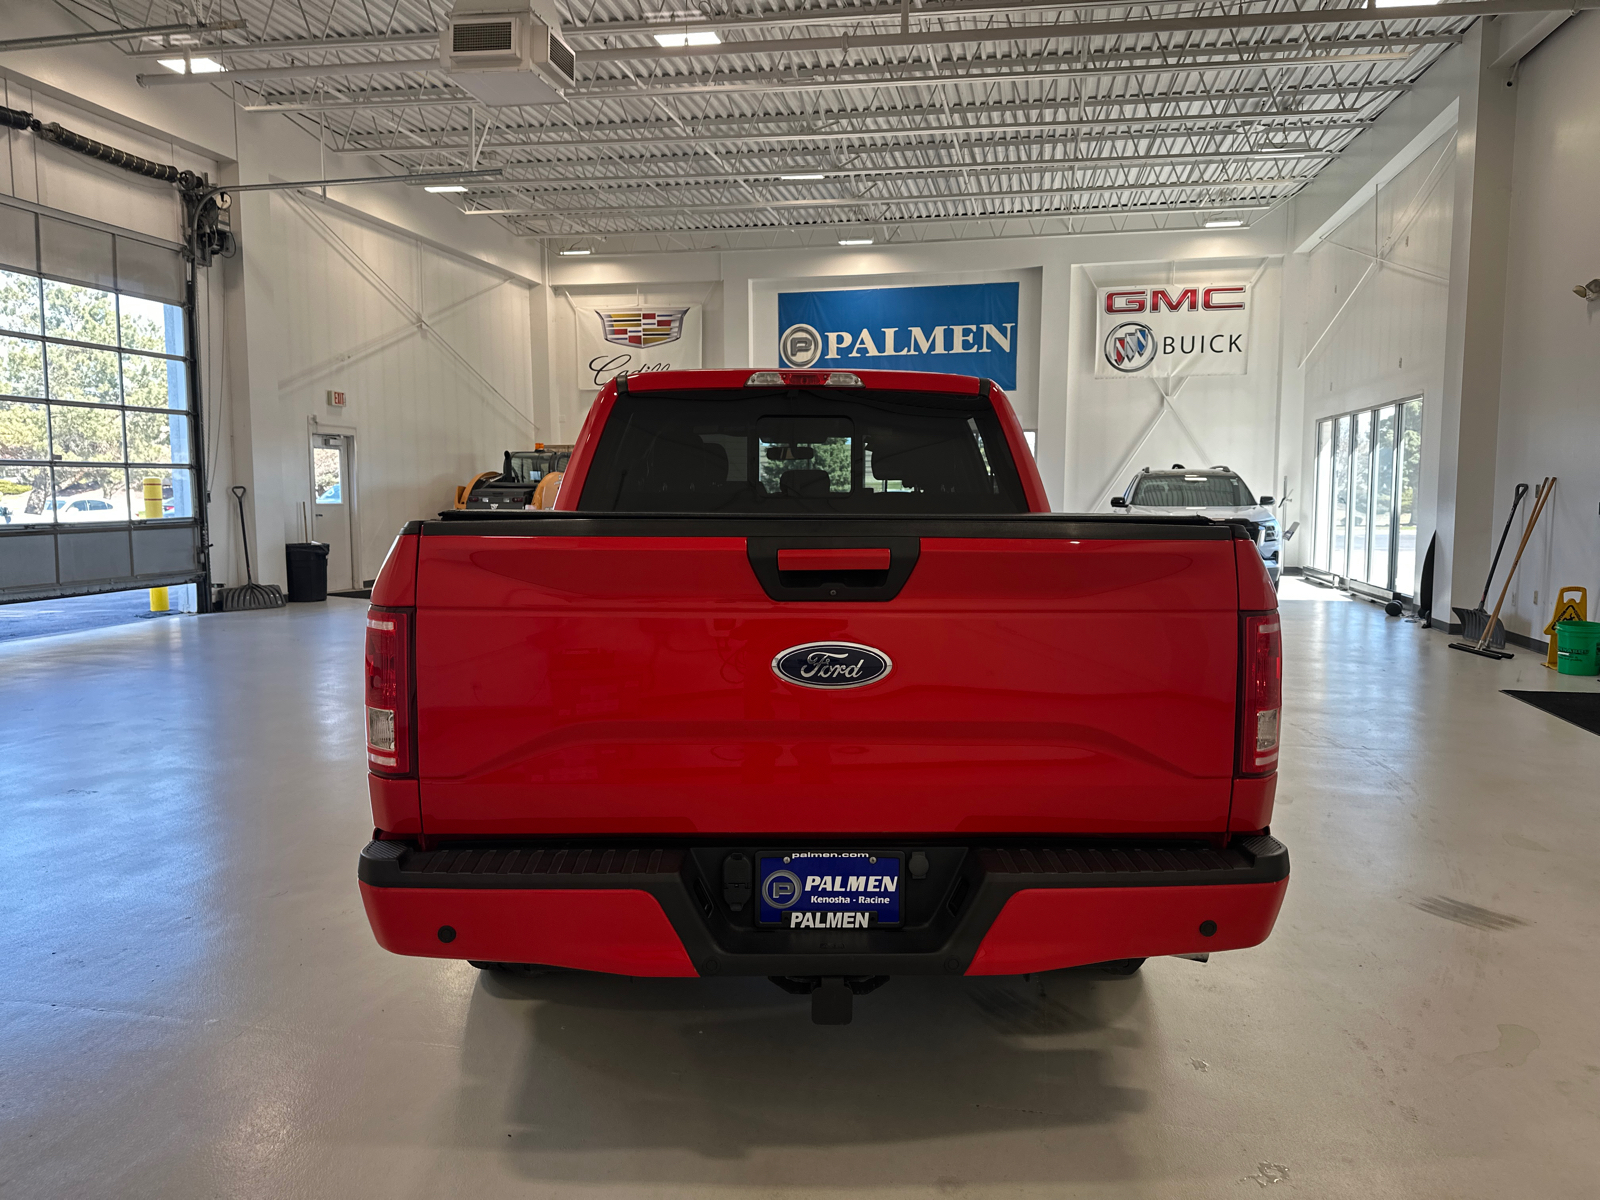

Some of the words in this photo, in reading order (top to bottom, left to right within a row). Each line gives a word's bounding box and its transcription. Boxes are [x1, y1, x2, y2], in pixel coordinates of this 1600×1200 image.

[1105, 285, 1246, 315] GMC
[824, 323, 1016, 359] PALMEN
[1162, 334, 1243, 355] BUICK
[800, 651, 865, 679] Ford
[804, 875, 899, 892] PALMEN
[810, 895, 851, 904] Kenosha
[858, 895, 890, 904] Racine
[789, 912, 870, 929] PALMEN
